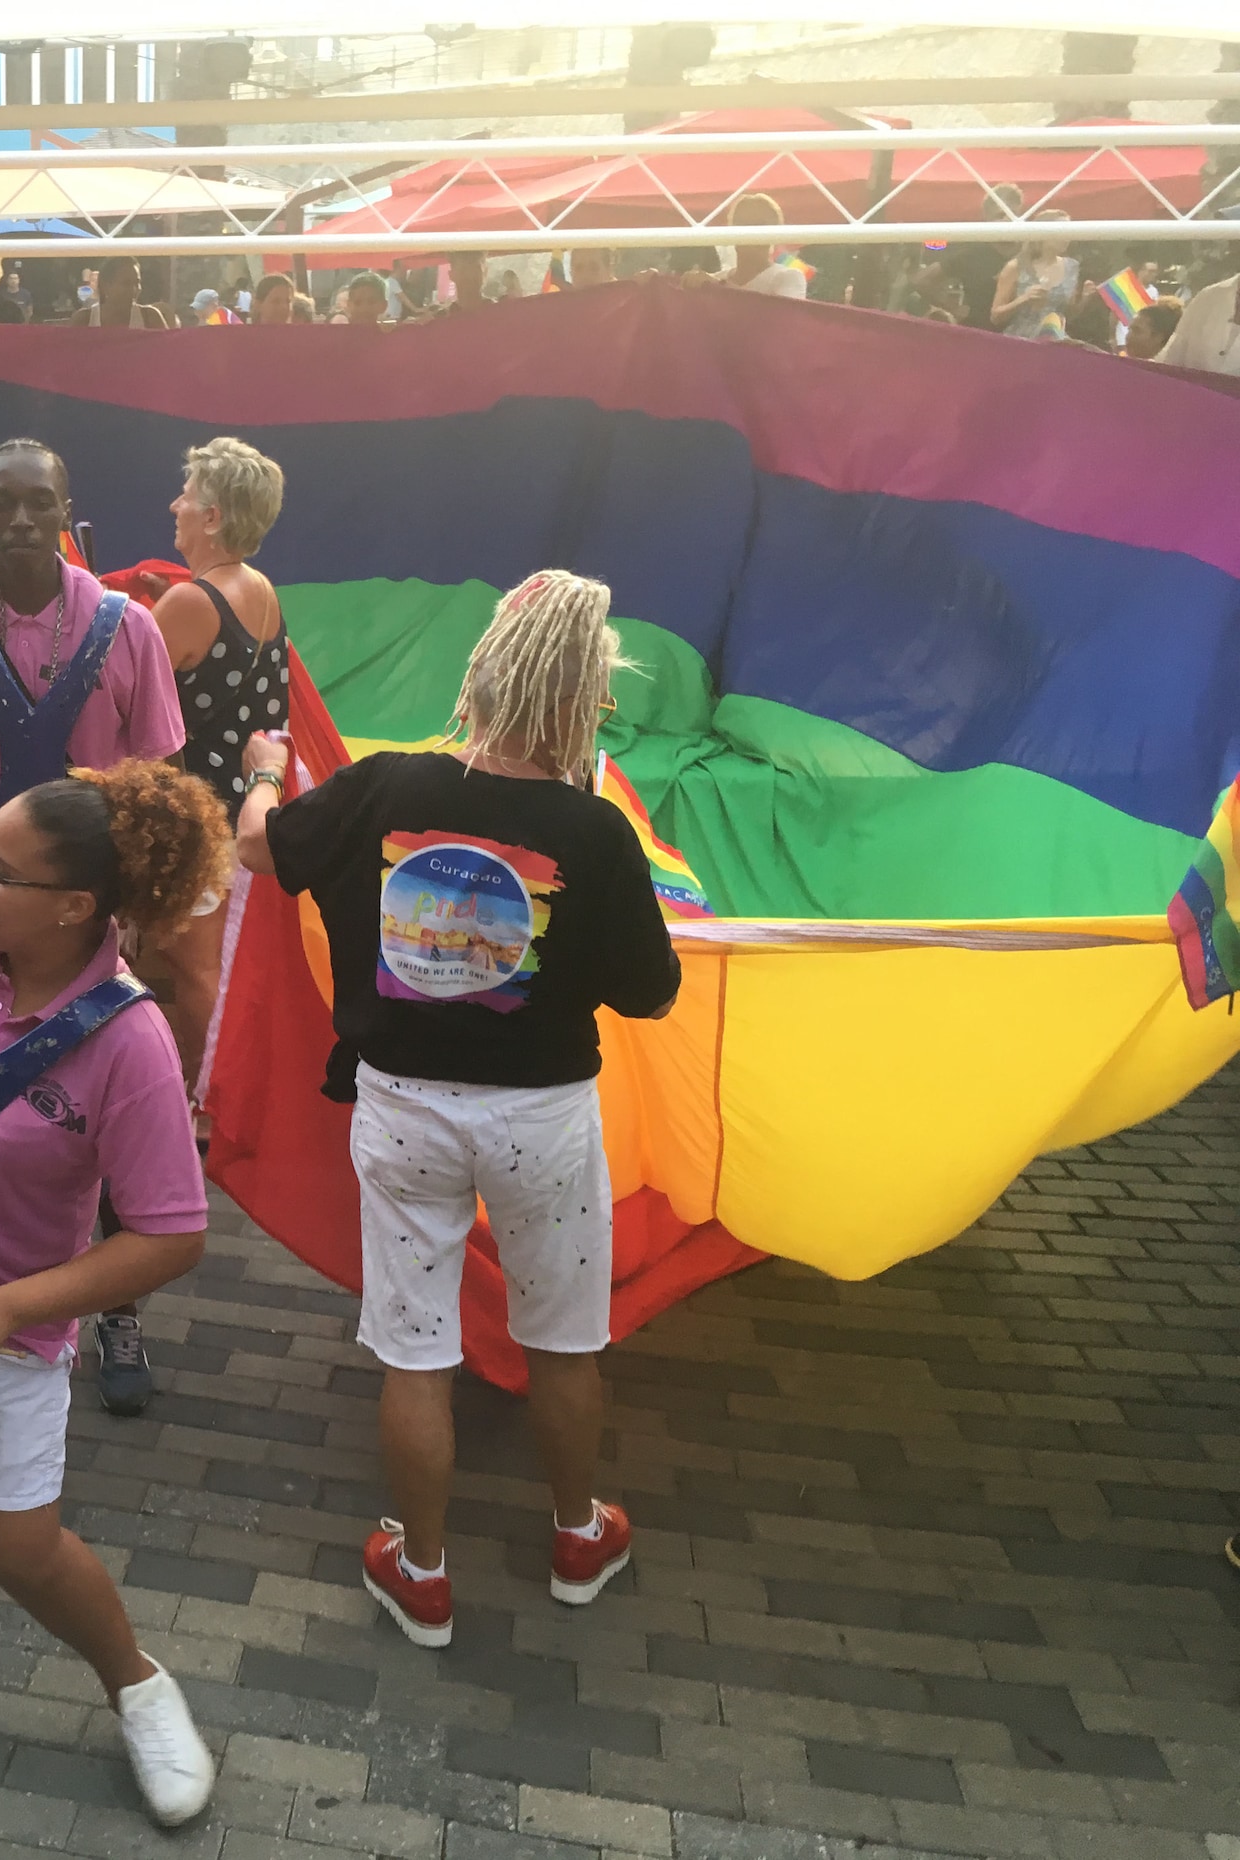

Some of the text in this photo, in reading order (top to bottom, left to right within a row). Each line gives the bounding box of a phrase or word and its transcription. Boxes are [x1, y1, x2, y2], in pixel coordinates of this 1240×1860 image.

[412, 891, 495, 926] pride
[397, 960, 488, 981] UNITED WE ARE ONE!
